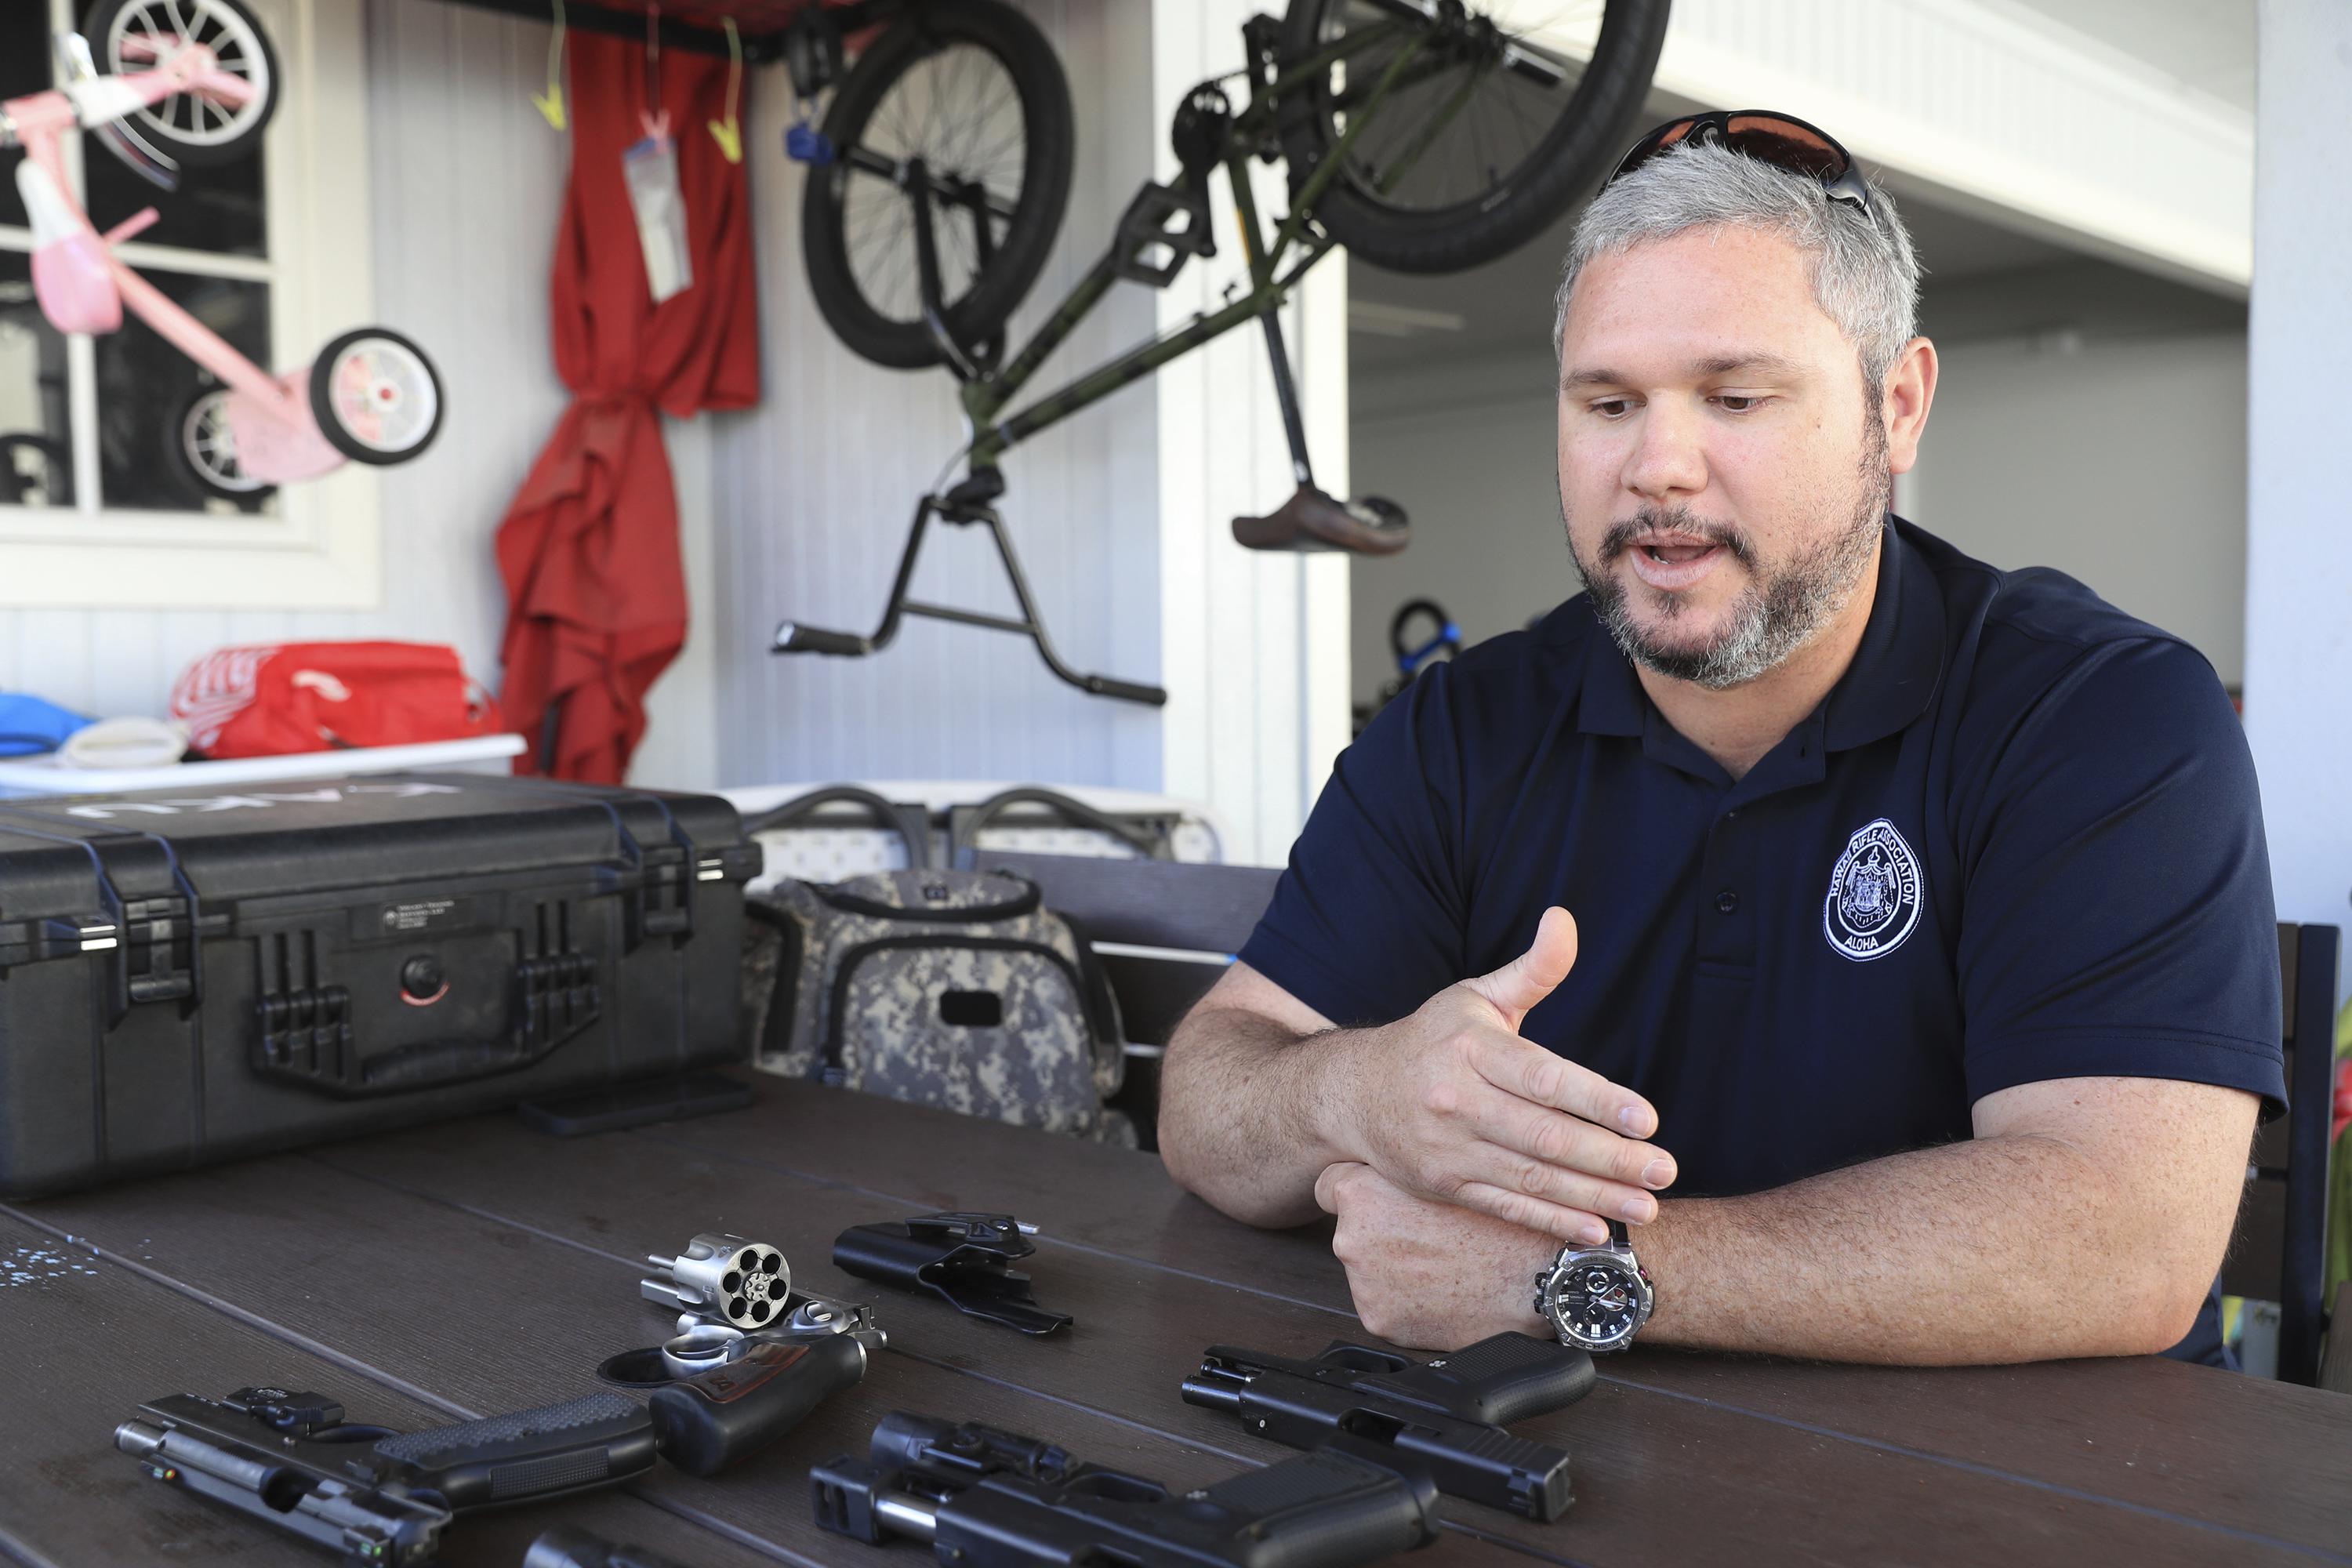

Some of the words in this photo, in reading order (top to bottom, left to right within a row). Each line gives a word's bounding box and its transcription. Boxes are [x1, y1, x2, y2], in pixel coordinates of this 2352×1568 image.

[1830, 849, 1853, 897] HAWAII
[1851, 829, 1878, 854] RIFLE
[1877, 827, 1915, 906] ASSOCIATION
[1844, 935, 1878, 951] ALOHA
[1573, 1338, 1619, 1351] G-SHOCK
